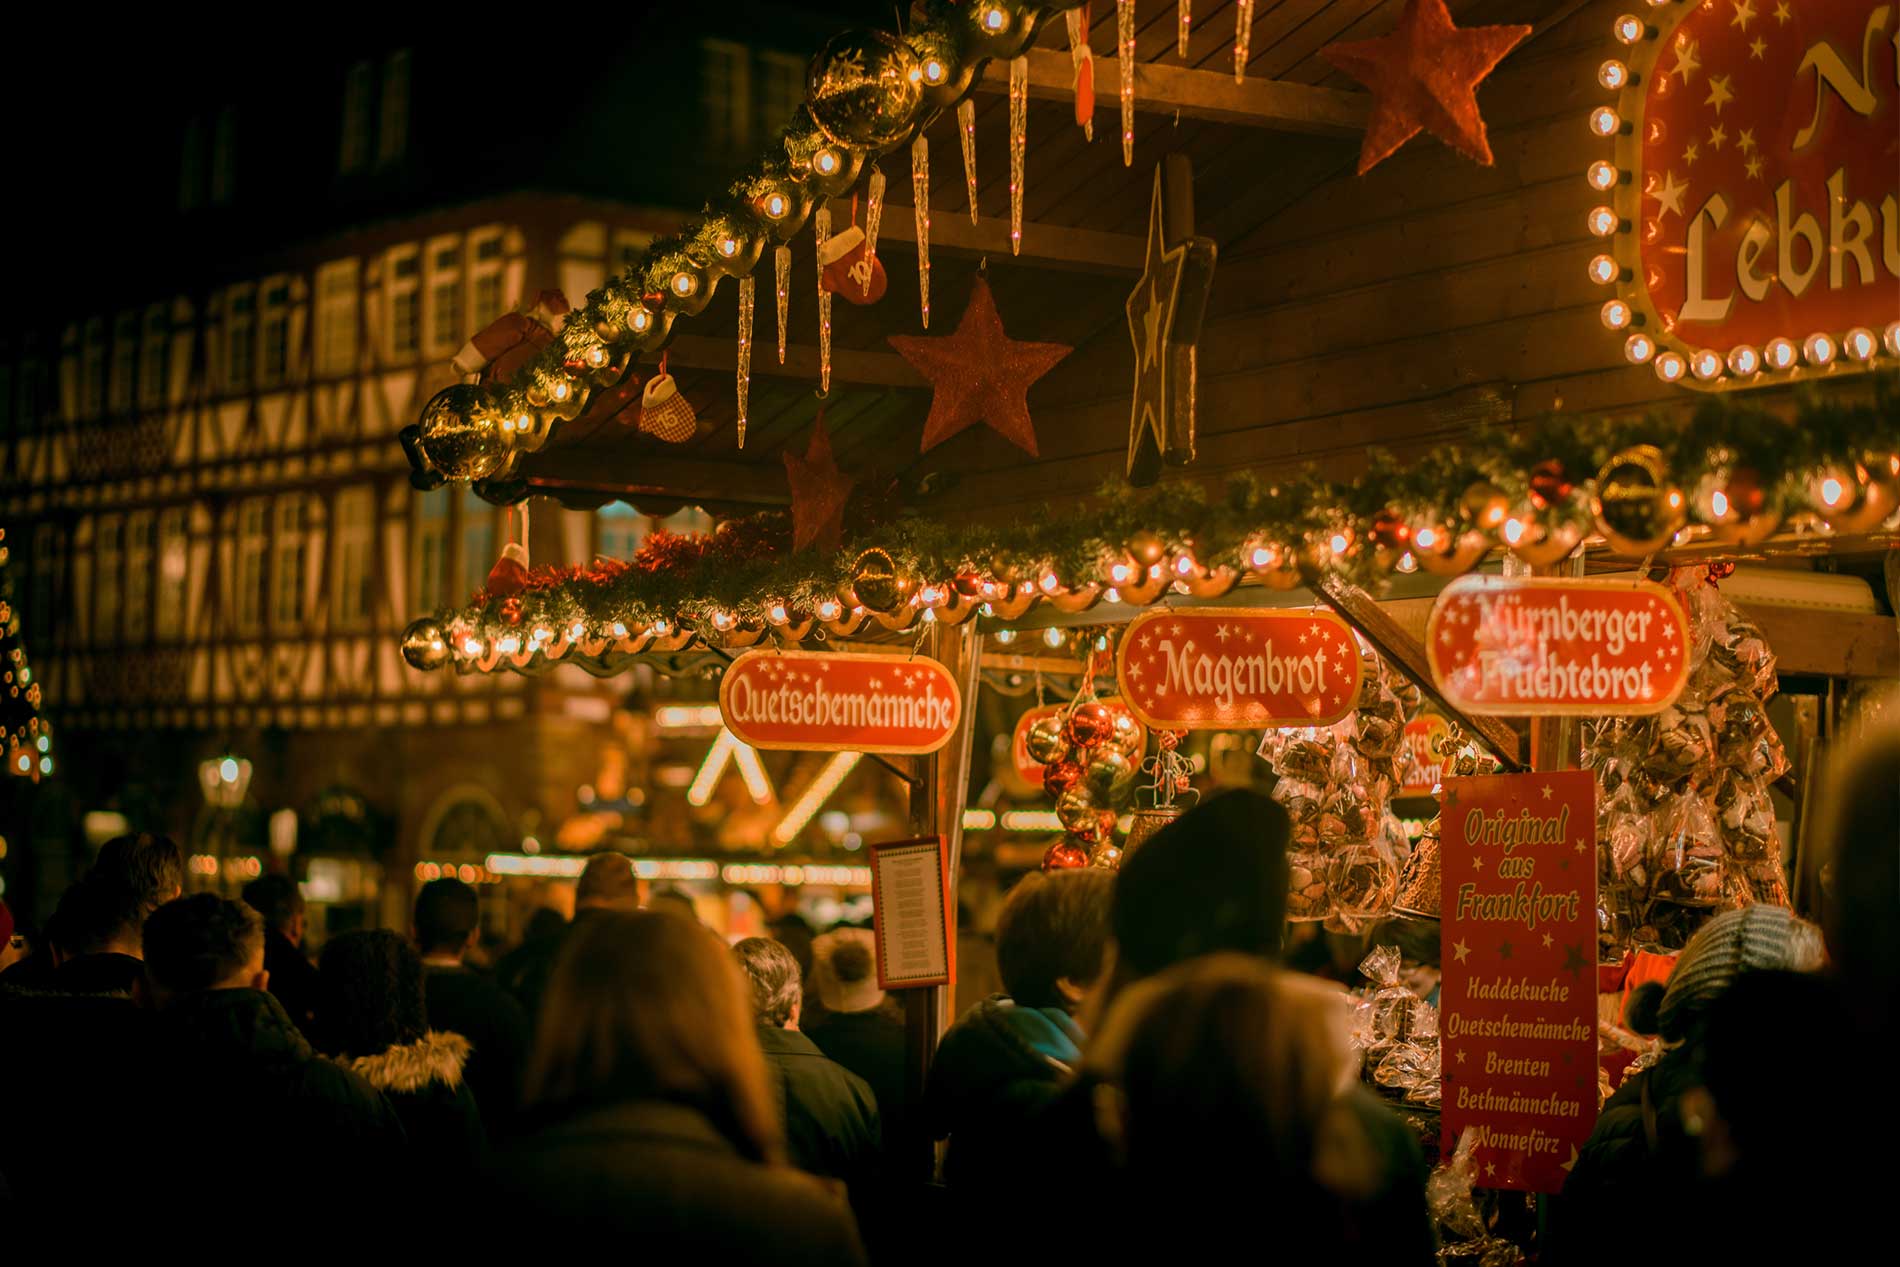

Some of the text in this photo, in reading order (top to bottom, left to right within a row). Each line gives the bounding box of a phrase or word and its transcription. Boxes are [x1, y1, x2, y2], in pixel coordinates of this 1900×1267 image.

[1793, 5, 1900, 150] N
[1474, 594, 1652, 656] Nürnberger
[1156, 638, 1328, 712] Magenbrot
[729, 672, 952, 730] Quetschemännche
[1464, 803, 1570, 855] Original
[1498, 856, 1536, 880] aus
[1456, 881, 1581, 931] Frankfort
[1466, 975, 1570, 1003] Haddekuche
[1447, 1012, 1591, 1042] Quetschemännche
[1485, 1051, 1551, 1078] Brenten
[1456, 1086, 1581, 1118] Bethmännchen
[1479, 1124, 1560, 1158] Nonneförz
